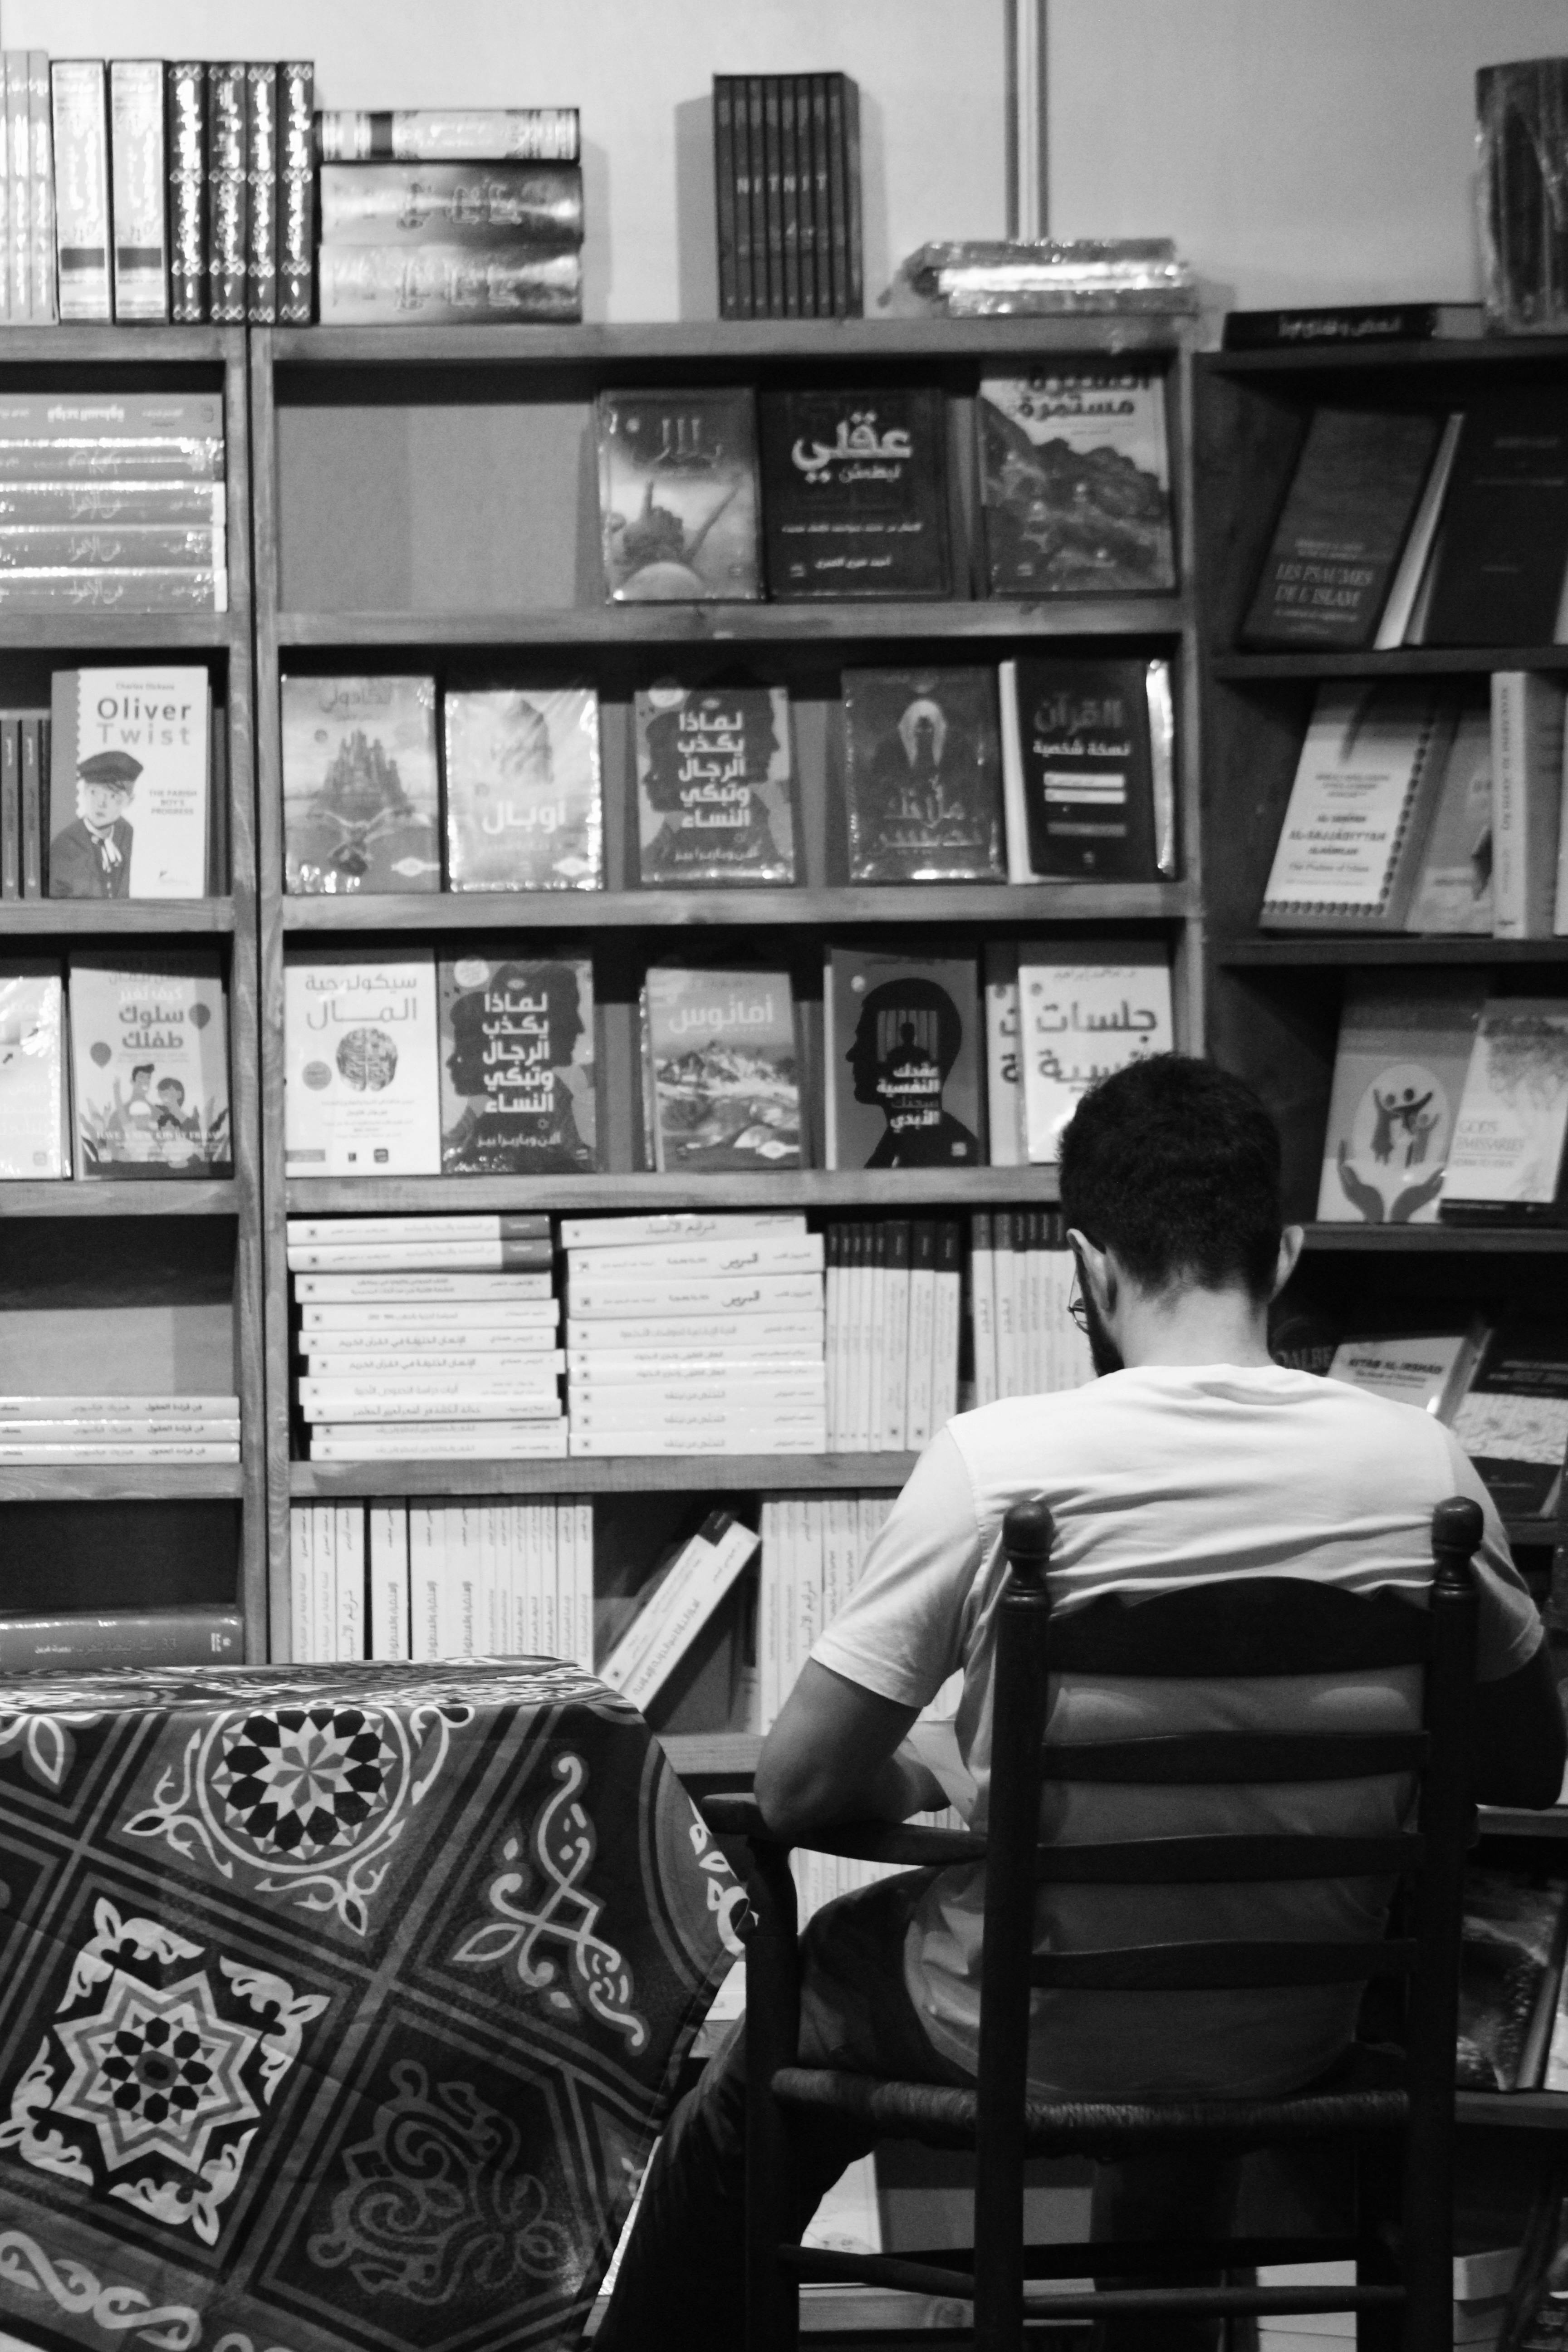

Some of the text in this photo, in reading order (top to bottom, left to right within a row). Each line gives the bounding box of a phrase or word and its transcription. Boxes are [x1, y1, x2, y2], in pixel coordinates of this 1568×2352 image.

[792, 411, 913, 484] عقلي
[97, 697, 191, 721] Oliver
[679, 710, 743, 731] لماذا
[1034, 694, 1122, 736] القرآن
[97, 723, 191, 745] Twist
[677, 733, 745, 757] يكذب
[1033, 737, 1131, 758] نسخة شخصية
[678, 759, 745, 782] الرجال
[679, 783, 751, 808] وتبكي
[681, 808, 751, 828] النساء
[305, 974, 417, 995] سيكولوجية
[307, 997, 417, 1030] المال
[484, 992, 548, 1012] لماذا
[668, 994, 773, 1034] أمانوس
[119, 1004, 184, 1029] سلوك
[482, 1014, 549, 1038] يكذب
[1035, 1000, 1157, 1043] جلسات
[122, 1031, 183, 1049] طفلك
[483, 1040, 549, 1066] الرجال
[484, 1066, 554, 1092] وتبكي
[876, 1078, 940, 1098] النفسية
[484, 1093, 554, 1113] النساء
